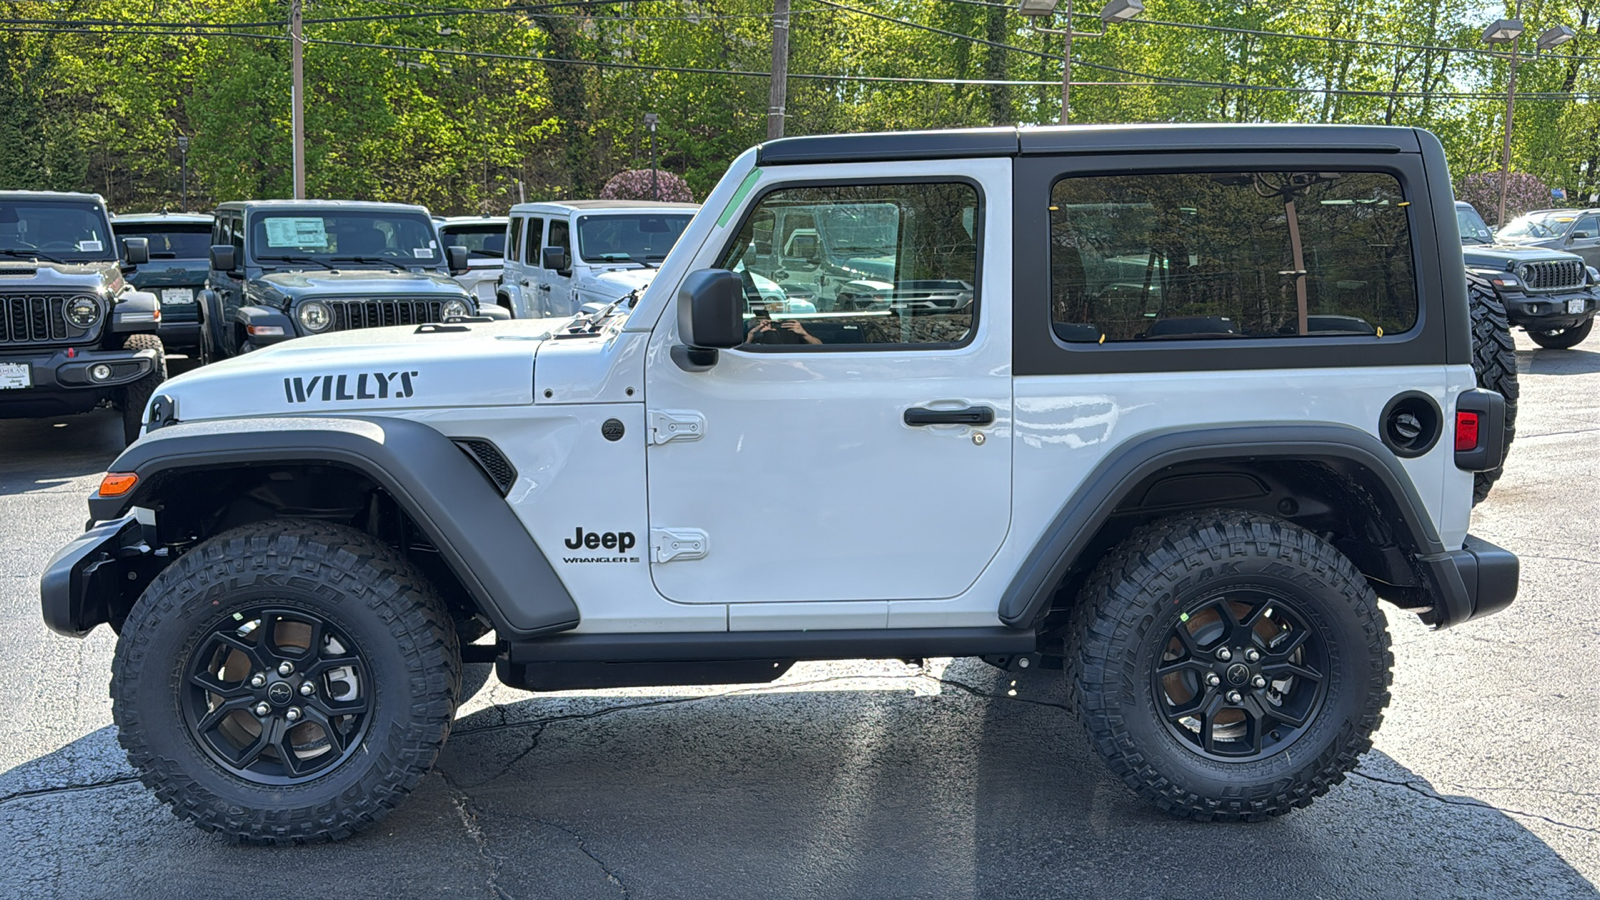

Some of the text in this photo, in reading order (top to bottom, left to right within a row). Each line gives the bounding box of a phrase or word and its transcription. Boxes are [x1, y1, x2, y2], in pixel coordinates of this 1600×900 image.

[284, 371, 419, 403] WILLYS
[564, 526, 636, 554] Jeep
[1121, 560, 1245, 705] WILDPEAK
